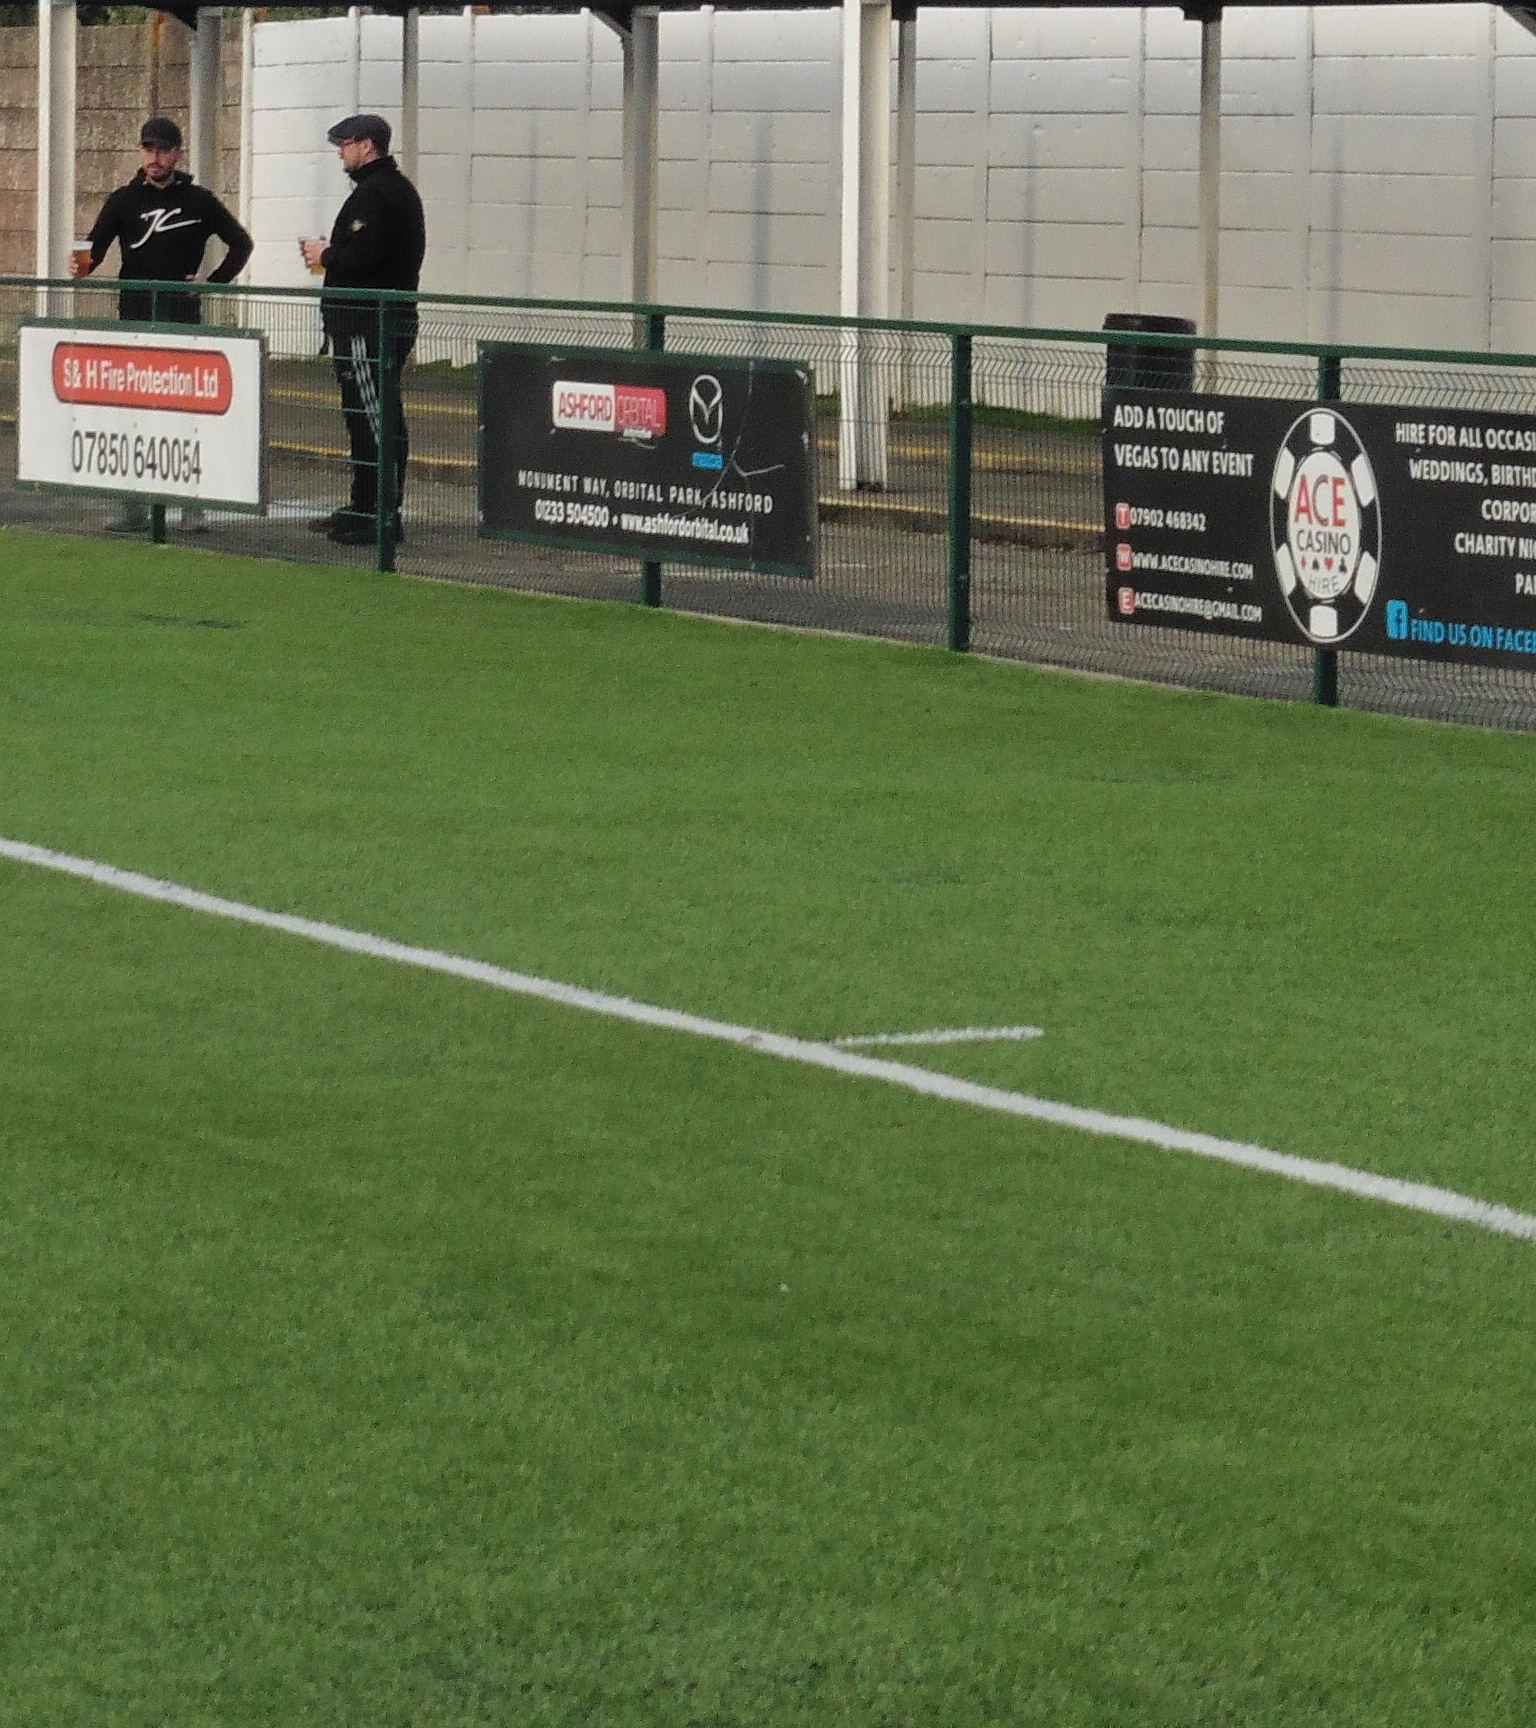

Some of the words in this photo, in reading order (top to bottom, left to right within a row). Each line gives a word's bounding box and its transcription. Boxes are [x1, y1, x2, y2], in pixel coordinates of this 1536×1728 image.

[63, 356, 82, 389] S&
[86, 359, 98, 390] H
[100, 359, 125, 392] Fire
[126, 362, 192, 397] Protection
[194, 367, 219, 398] Ltd
[559, 392, 611, 421] ASHFORD
[618, 396, 661, 427] ORBITAL
[1114, 404, 1143, 429] ADD
[1146, 407, 1156, 429] A
[1157, 408, 1205, 433] TOUCH
[1207, 411, 1224, 434] OF
[1396, 423, 1424, 445] HIRE
[1428, 425, 1454, 447] FOR
[1457, 427, 1483, 449] ALL
[71, 429, 128, 476] 07850
[133, 433, 202, 484] 640054
[1115, 444, 1159, 469] VEGAS
[1161, 447, 1179, 471] TO
[1183, 448, 1212, 473] ANY
[1214, 451, 1253, 477] EVENT
[1410, 460, 1487, 486] WEDDINGS,
[518, 470, 578, 492] MONUMENT
[584, 477, 610, 498] WAY,
[614, 479, 663, 502] ORBITAL
[669, 486, 705, 507] PARK,
[711, 491, 773, 514] ASHFORD
[1295, 475, 1345, 527] ACE
[535, 500, 564, 522] 01233
[566, 503, 609, 528] 504500
[621, 513, 749, 544] www.ashfordorbital.co.uk
[1131, 507, 1163, 528] 07902
[1166, 511, 1206, 532] 468342
[1296, 529, 1351, 555] CASINO
[1455, 533, 1515, 559] CHARITY
[1133, 552, 1253, 580] WWW.ACECASINOHIRE.COM
[1309, 575, 1339, 593] HIRE
[1135, 592, 1262, 622] ACECASINOHIRE@GMAIL.COM
[1411, 619, 1444, 642] FIND
[1448, 623, 1467, 645] US
[1470, 625, 1492, 648] ON
